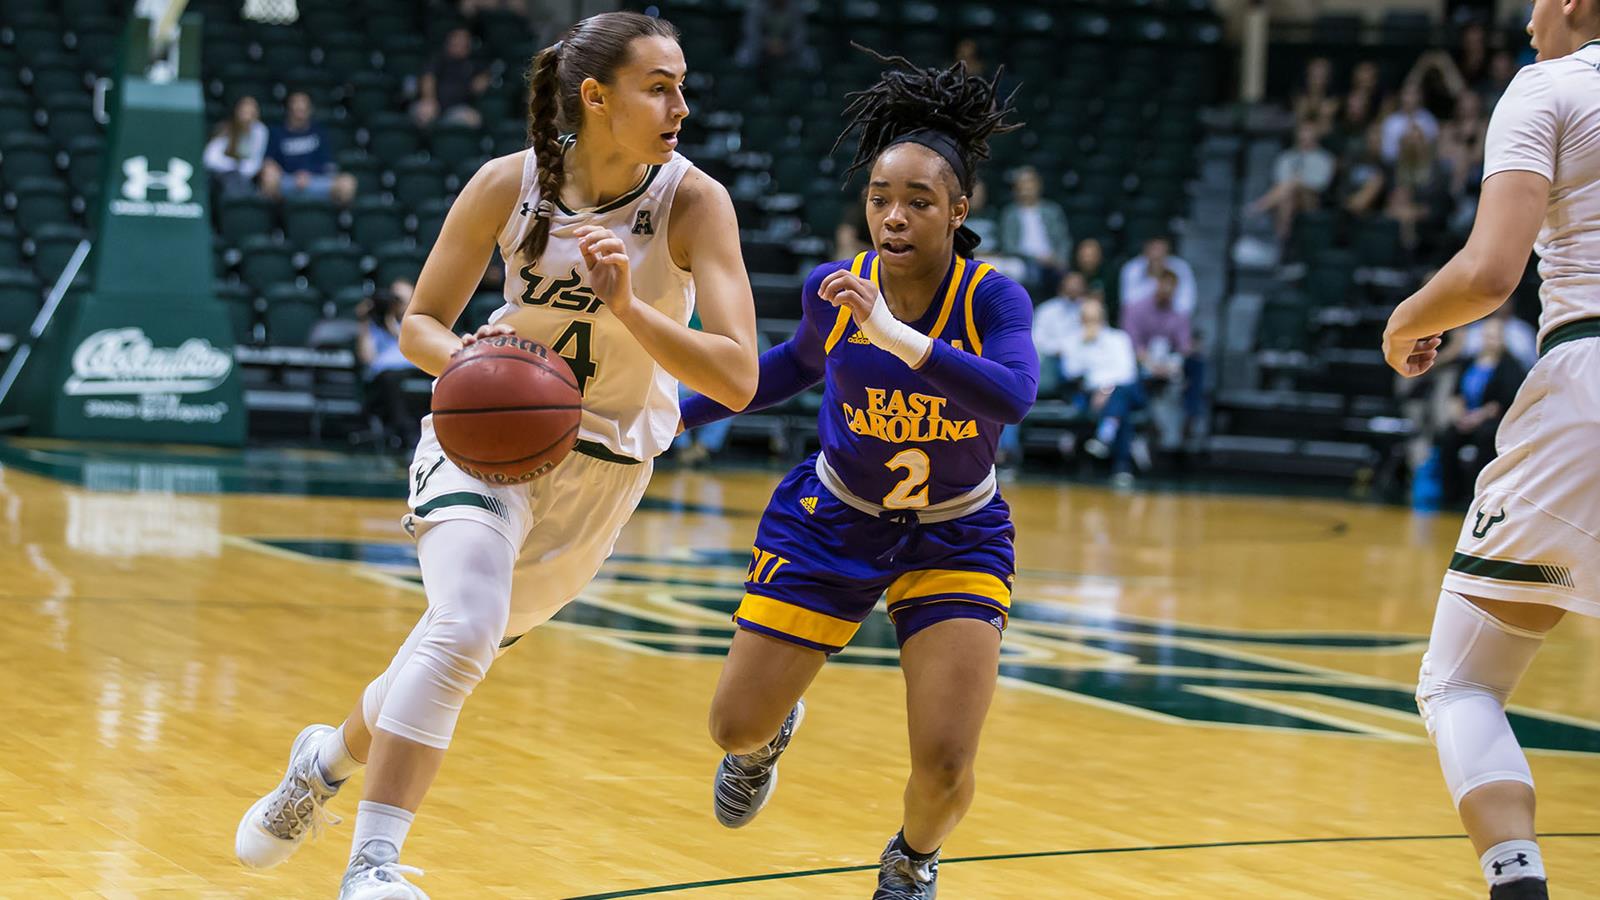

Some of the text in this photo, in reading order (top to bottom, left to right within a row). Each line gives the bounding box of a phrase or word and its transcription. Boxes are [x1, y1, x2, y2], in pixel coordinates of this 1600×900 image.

[549, 319, 599, 399] 4
[842, 402, 980, 444] CAROLINA
[865, 386, 948, 420] EAST
[882, 448, 931, 510] 2
